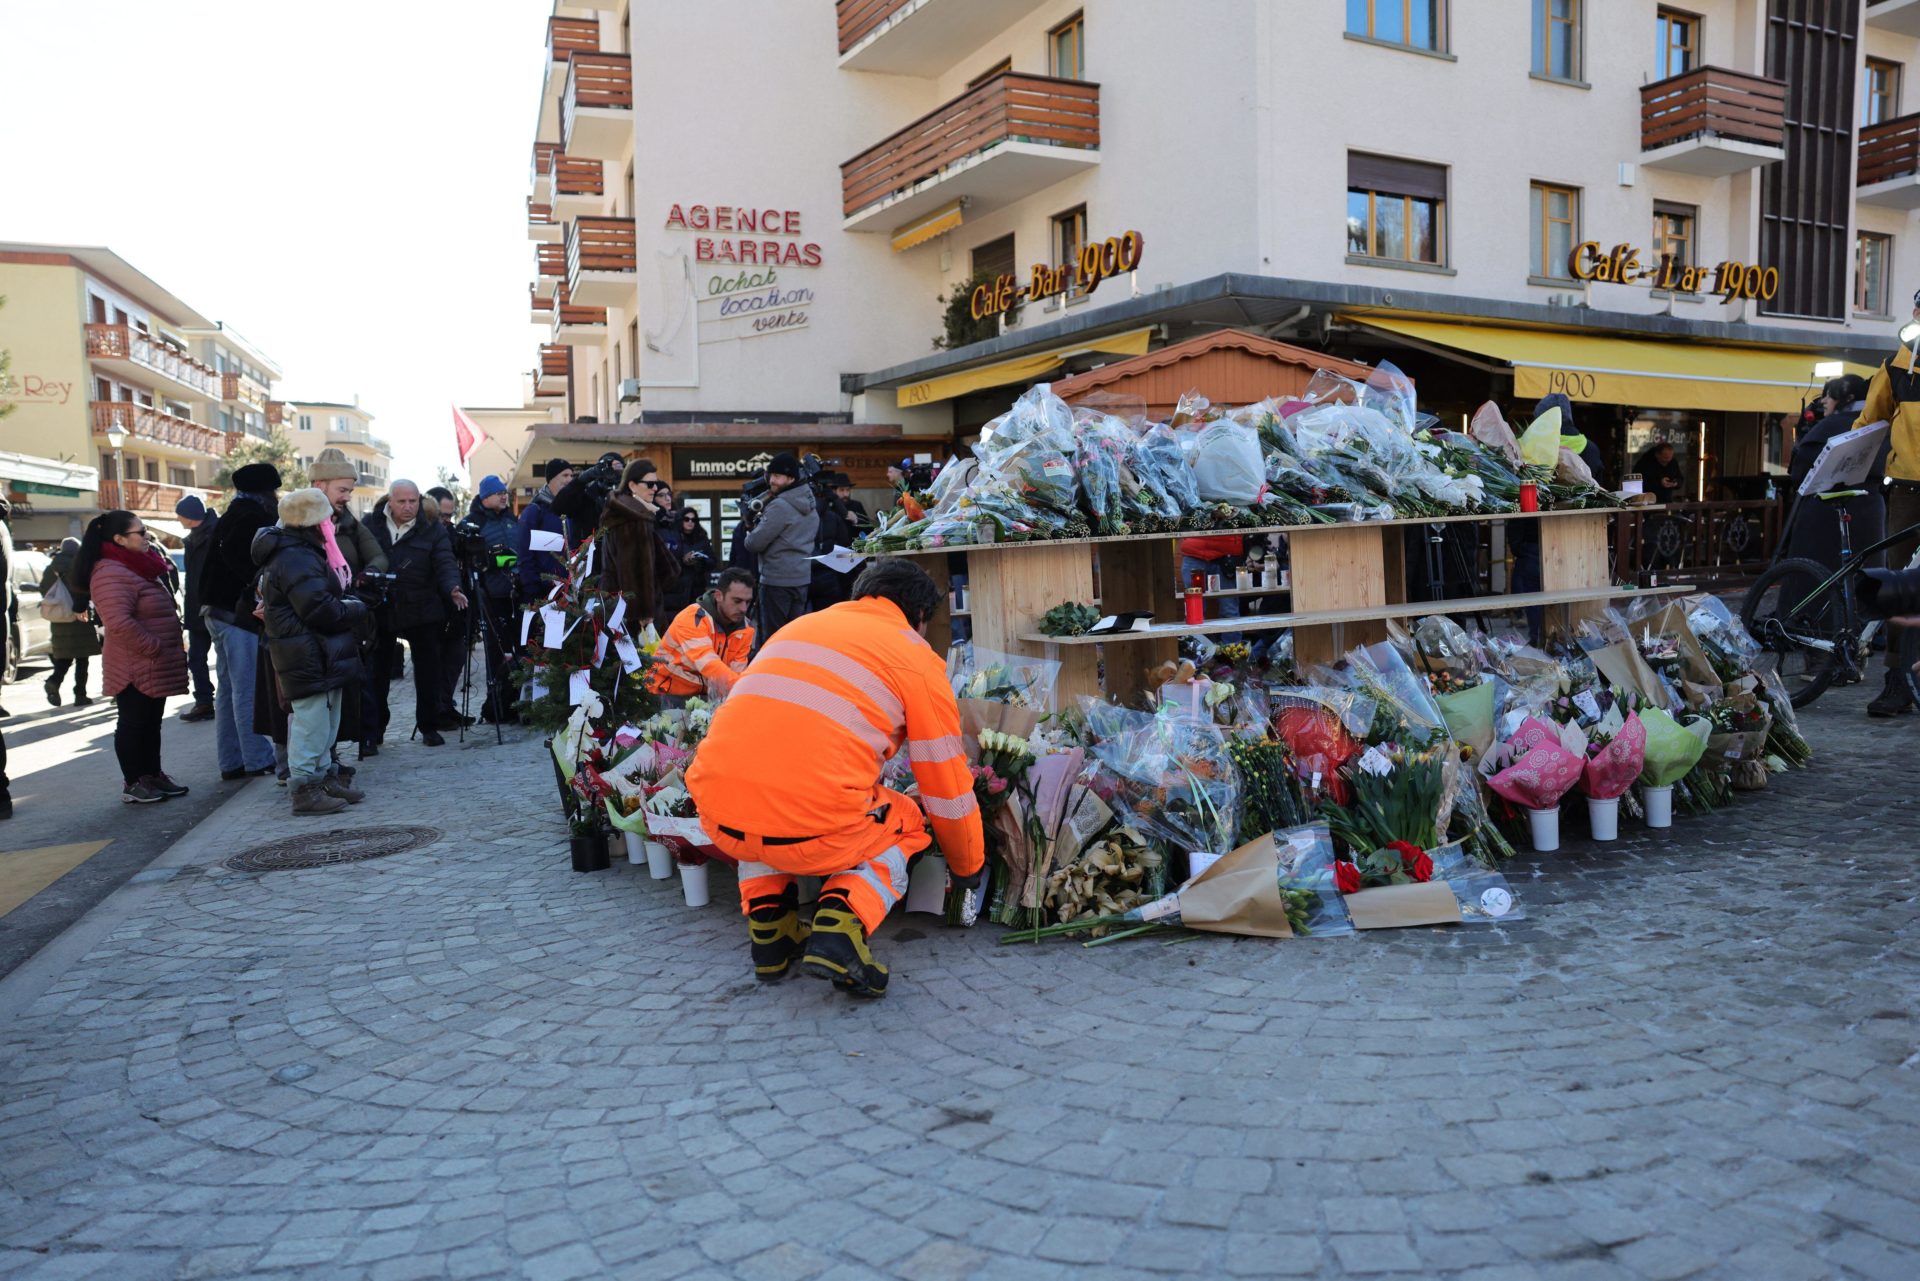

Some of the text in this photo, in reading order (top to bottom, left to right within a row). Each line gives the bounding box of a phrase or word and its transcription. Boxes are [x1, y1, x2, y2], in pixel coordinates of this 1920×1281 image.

[665, 204, 801, 234] AGENCE
[696, 238, 822, 267] BARRAS
[1076, 229, 1142, 294] 1900
[708, 266, 777, 295] achat
[1714, 260, 1778, 305] 1900
[720, 287, 814, 316] location
[752, 311, 808, 331] vente
[24, 375, 72, 404] Rey
[1548, 370, 1596, 398] 1900
